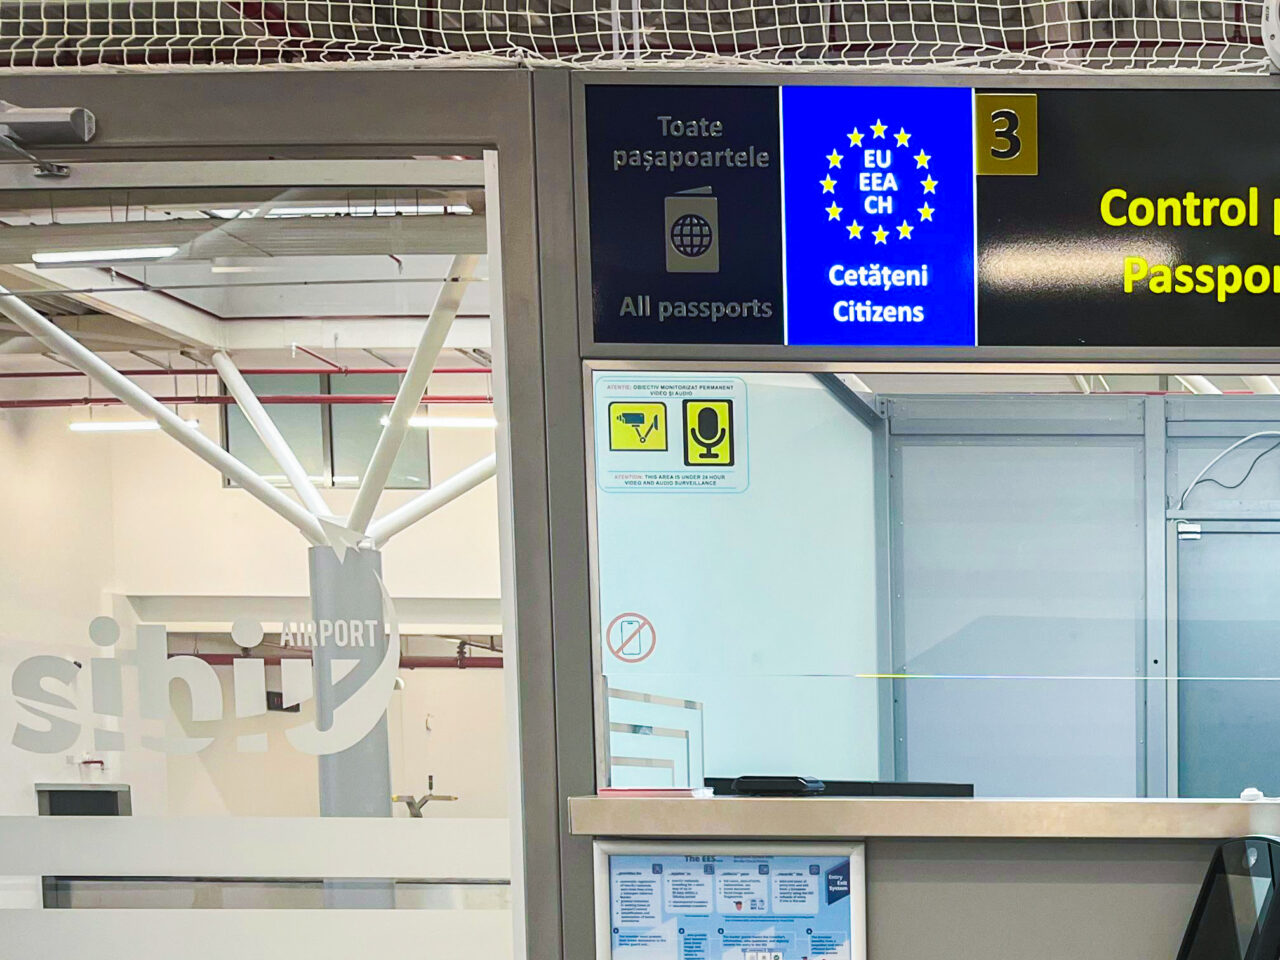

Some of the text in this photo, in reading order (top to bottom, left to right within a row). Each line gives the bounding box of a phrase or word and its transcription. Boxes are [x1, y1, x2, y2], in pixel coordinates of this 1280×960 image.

[656, 115, 723, 137] Toate
[990, 108, 1023, 161] 3
[613, 145, 770, 172] pașapoartele
[863, 149, 892, 169] EU
[859, 172, 899, 192] EEA
[863, 195, 893, 215] CH
[1101, 186, 1259, 227] Control
[828, 263, 929, 292] Cetățeni
[619, 295, 773, 323] All passports
[832, 299, 925, 323] Citizens
[280, 619, 378, 648] AIRPORT
[11, 616, 399, 755] sibiu
